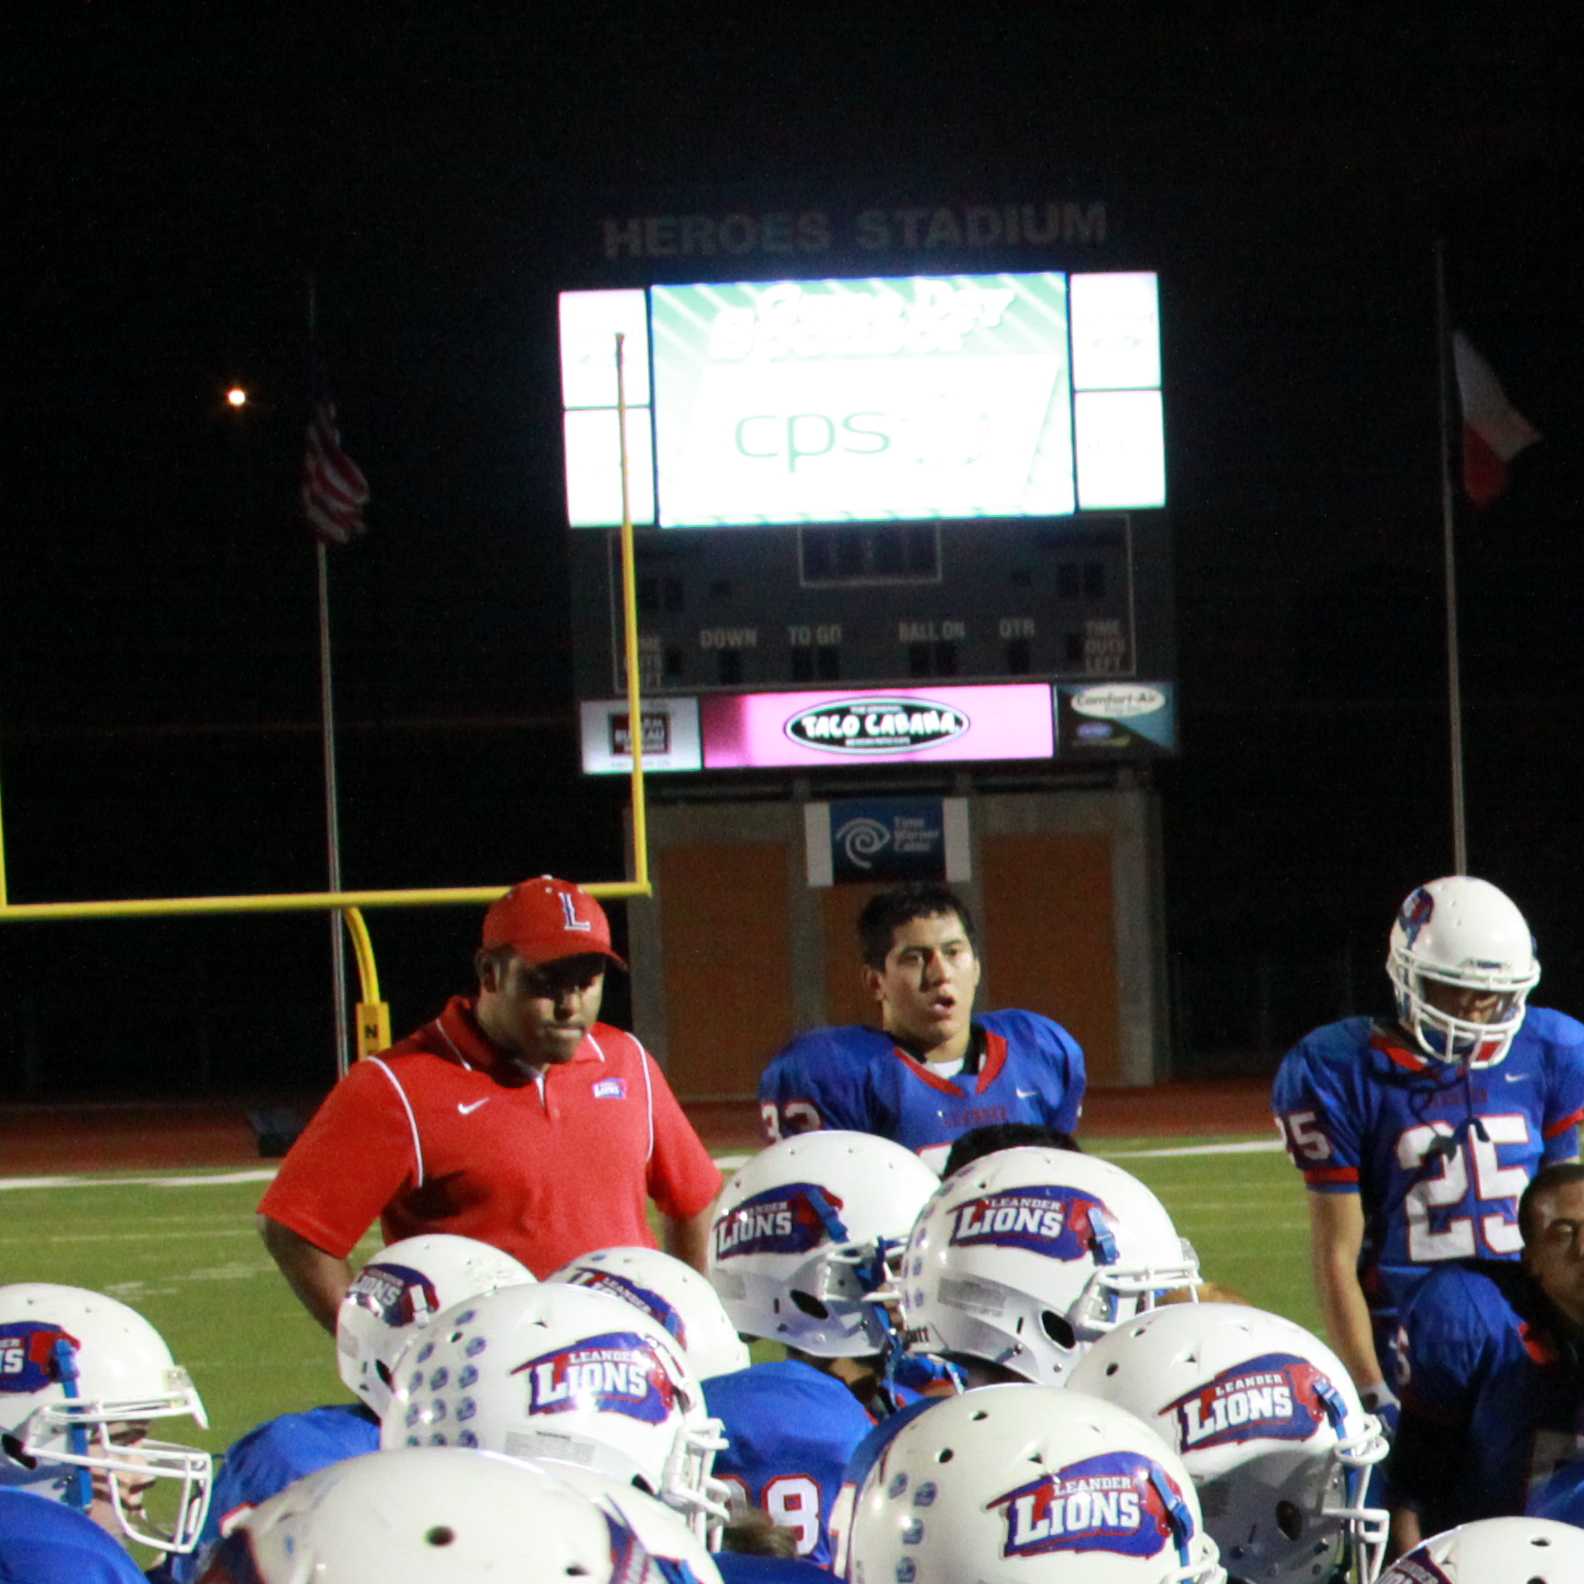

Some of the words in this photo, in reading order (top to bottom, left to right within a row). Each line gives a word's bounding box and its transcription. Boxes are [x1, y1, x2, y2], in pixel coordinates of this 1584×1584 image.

[600, 211, 831, 259] HEROES
[854, 202, 1109, 250] STADIUM
[734, 411, 892, 475] cps
[700, 629, 758, 649] DOWN
[788, 626, 811, 646] TO
[815, 625, 842, 644] GO
[899, 622, 940, 642] BALL
[801, 715, 861, 738] TACO
[865, 710, 956, 735] CABANA
[559, 891, 592, 932] L
[365, 1024, 379, 1039] N
[990, 1196, 1061, 1213] LEANDER
[1393, 1112, 1532, 1264] 25
[717, 1208, 793, 1252] LIONS
[955, 1204, 1065, 1242] LIONS
[537, 1360, 650, 1405] LIONS
[1214, 1373, 1284, 1395] LEANDER
[1182, 1385, 1294, 1446] LIONS
[1052, 1475, 1133, 1498] LEANDER
[1012, 1489, 1142, 1548] LIONS
